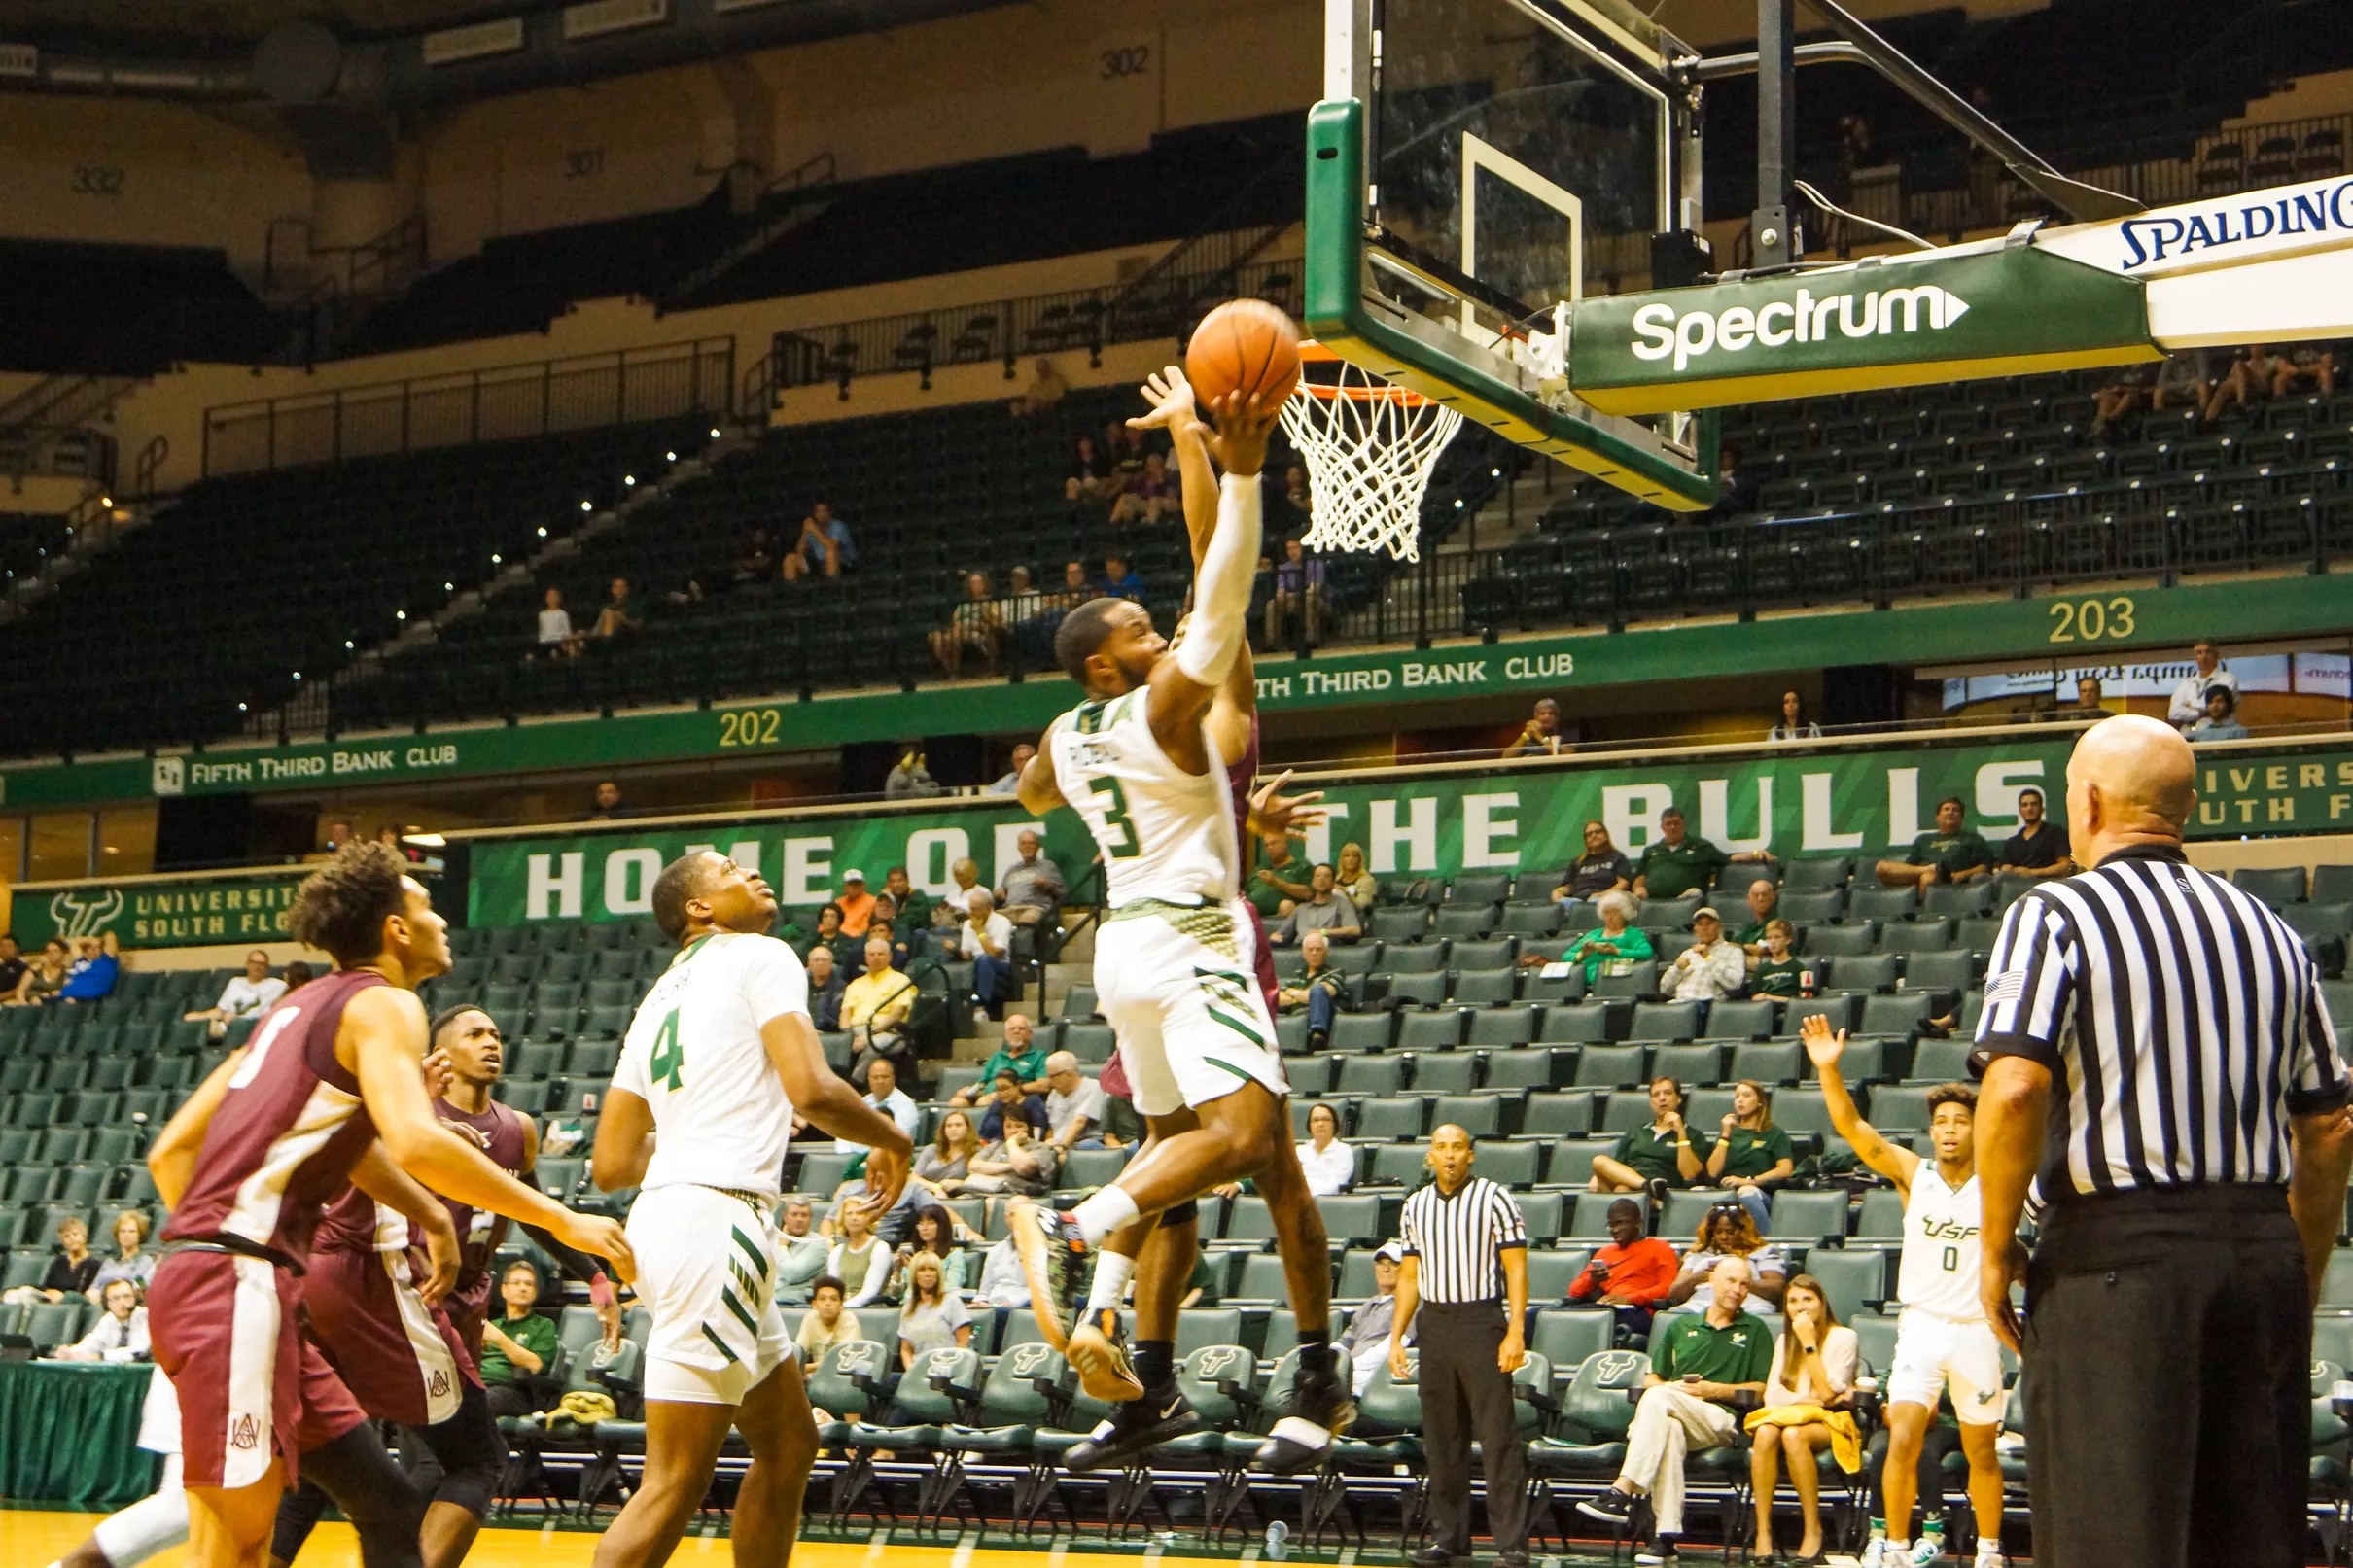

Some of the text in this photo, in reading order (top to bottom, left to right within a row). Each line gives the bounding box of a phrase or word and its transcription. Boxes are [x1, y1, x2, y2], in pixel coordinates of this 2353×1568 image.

[1100, 45, 1149, 78] 302
[1632, 285, 1946, 371] Spectrum
[2049, 596, 2136, 643] 203
[1300, 668, 1393, 696] THIRD
[1401, 660, 1488, 688] BANK
[1504, 653, 1575, 679] CLUB
[720, 708, 781, 747] 202
[191, 745, 458, 784] FIFTH THIRD BANK CLUB
[1087, 775, 1141, 859] 3
[1291, 791, 1521, 874] THE
[1602, 760, 2047, 860] BULLS
[2198, 797, 2295, 825] UTH
[135, 887, 294, 916] UNIVERSIT
[134, 917, 225, 940] SOUTH
[650, 1005, 685, 1092] 4
[1922, 1214, 1981, 1240] USF
[1943, 1245, 1958, 1272] 0
